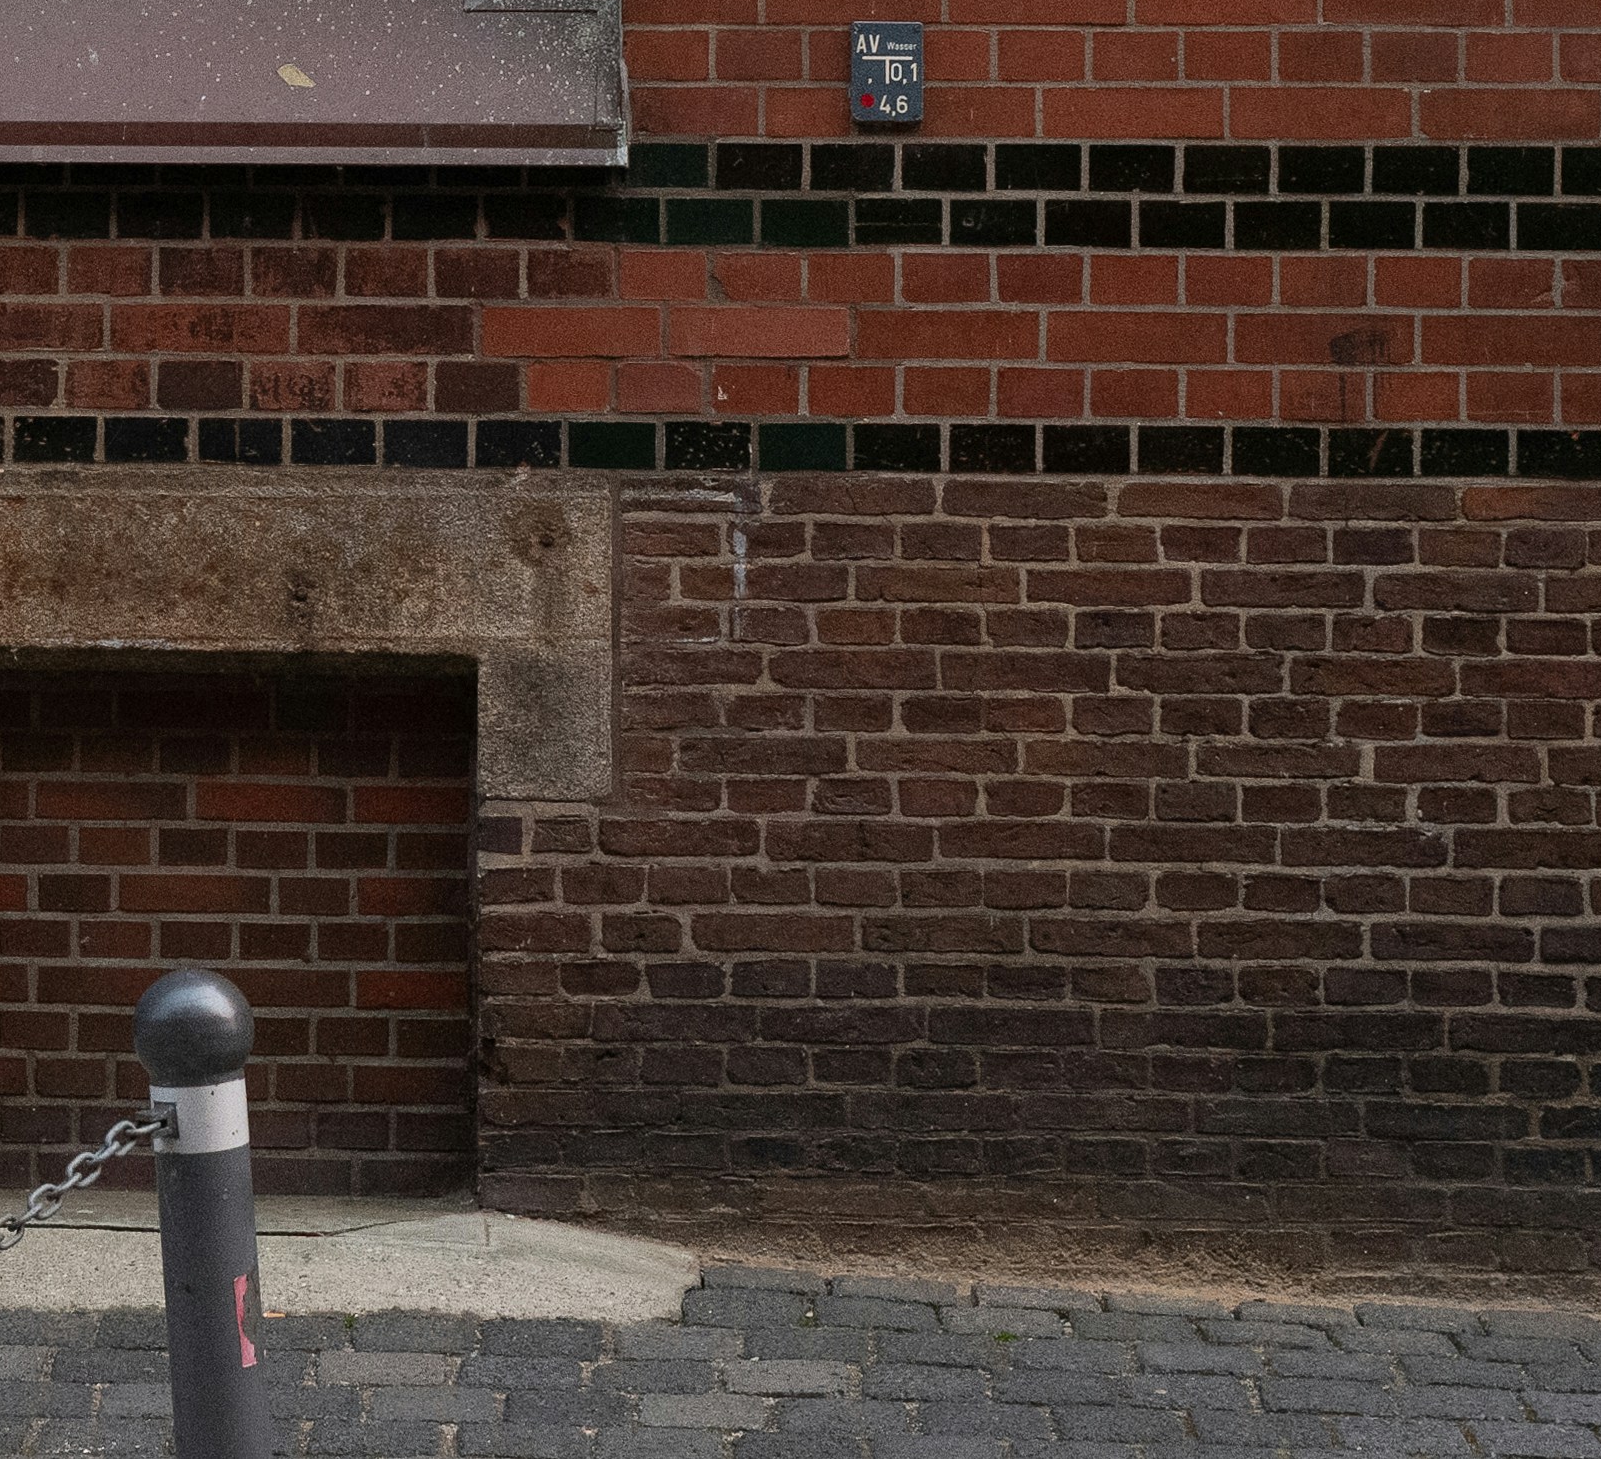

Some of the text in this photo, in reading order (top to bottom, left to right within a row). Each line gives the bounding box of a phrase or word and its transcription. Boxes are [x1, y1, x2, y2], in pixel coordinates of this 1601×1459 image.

[856, 34, 917, 54] AV Wasser
[890, 63, 918, 85] 0,1
[879, 94, 908, 117] 4,6
